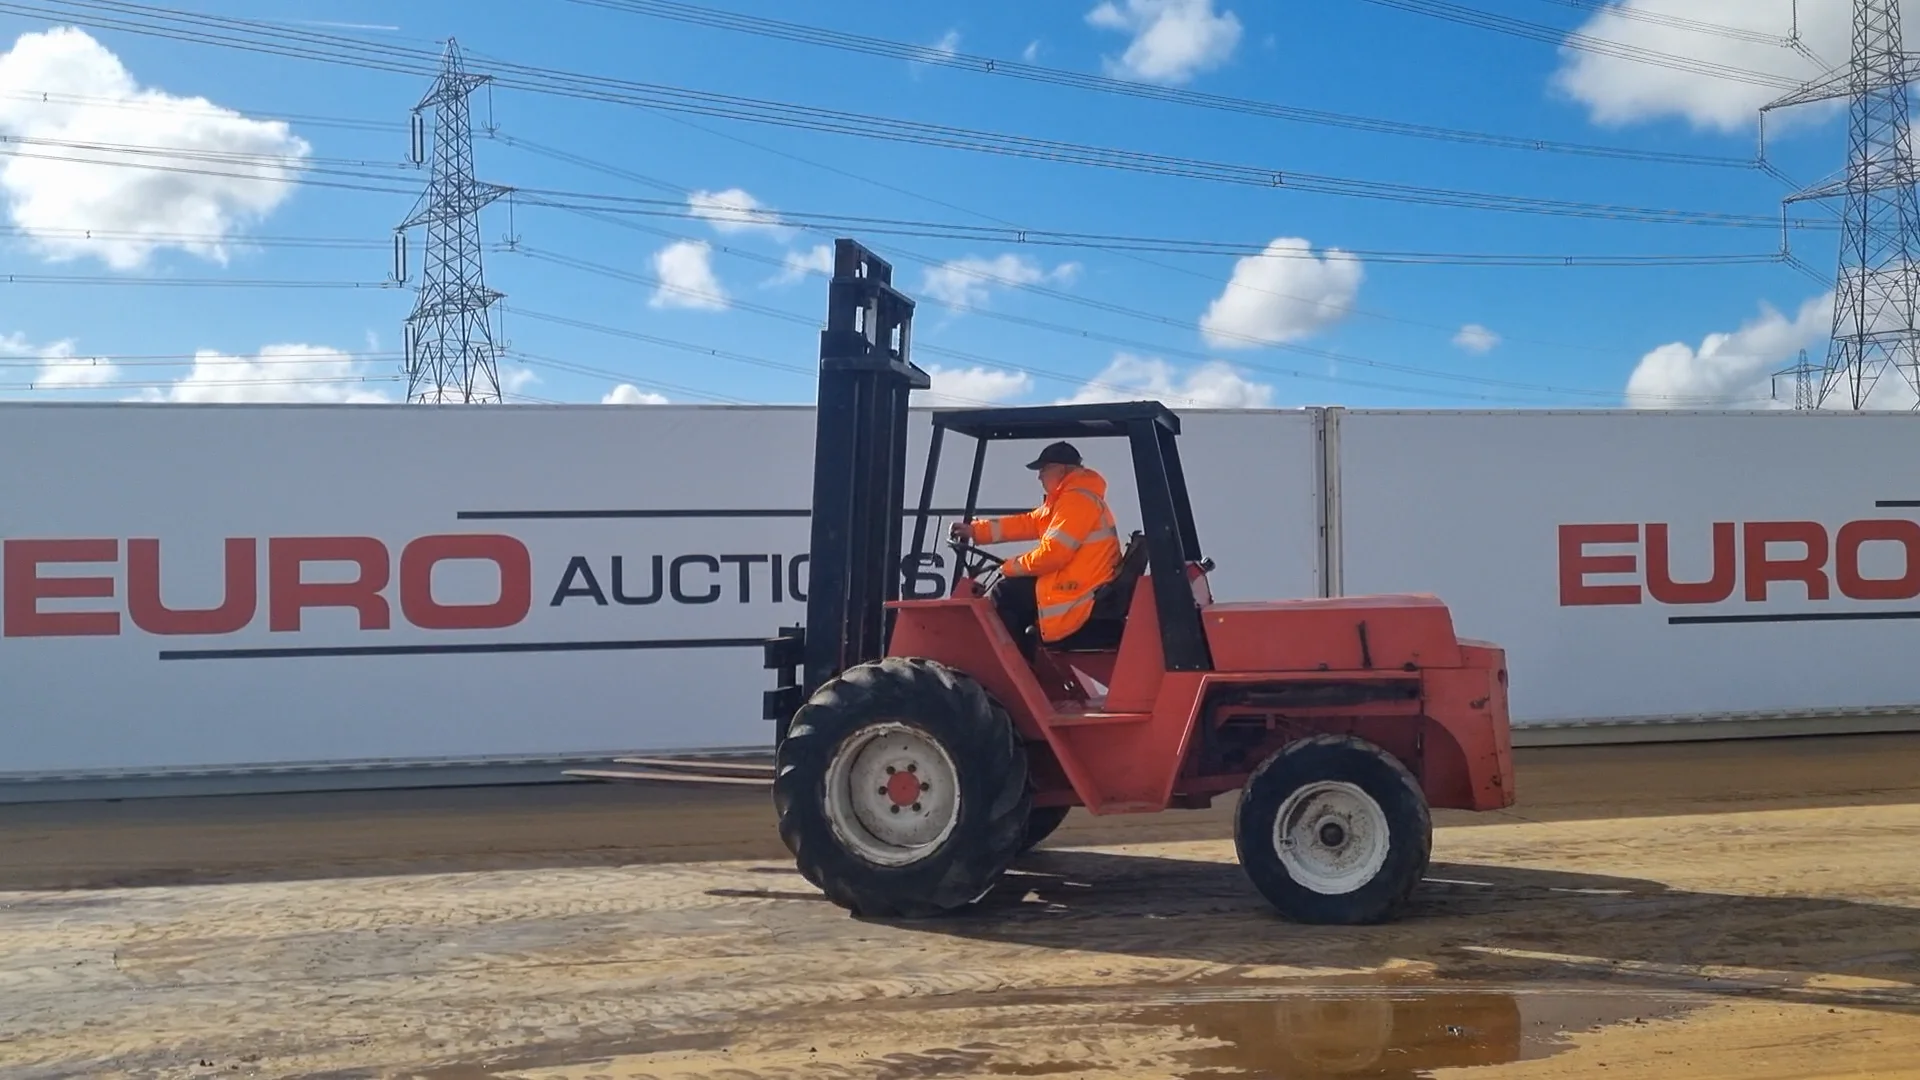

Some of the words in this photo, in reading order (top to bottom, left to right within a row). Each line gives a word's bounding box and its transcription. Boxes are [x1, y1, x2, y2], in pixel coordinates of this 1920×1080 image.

[4, 534, 531, 637] EURO
[549, 552, 946, 607] AUCTIS
[1558, 519, 1920, 606] EURO
